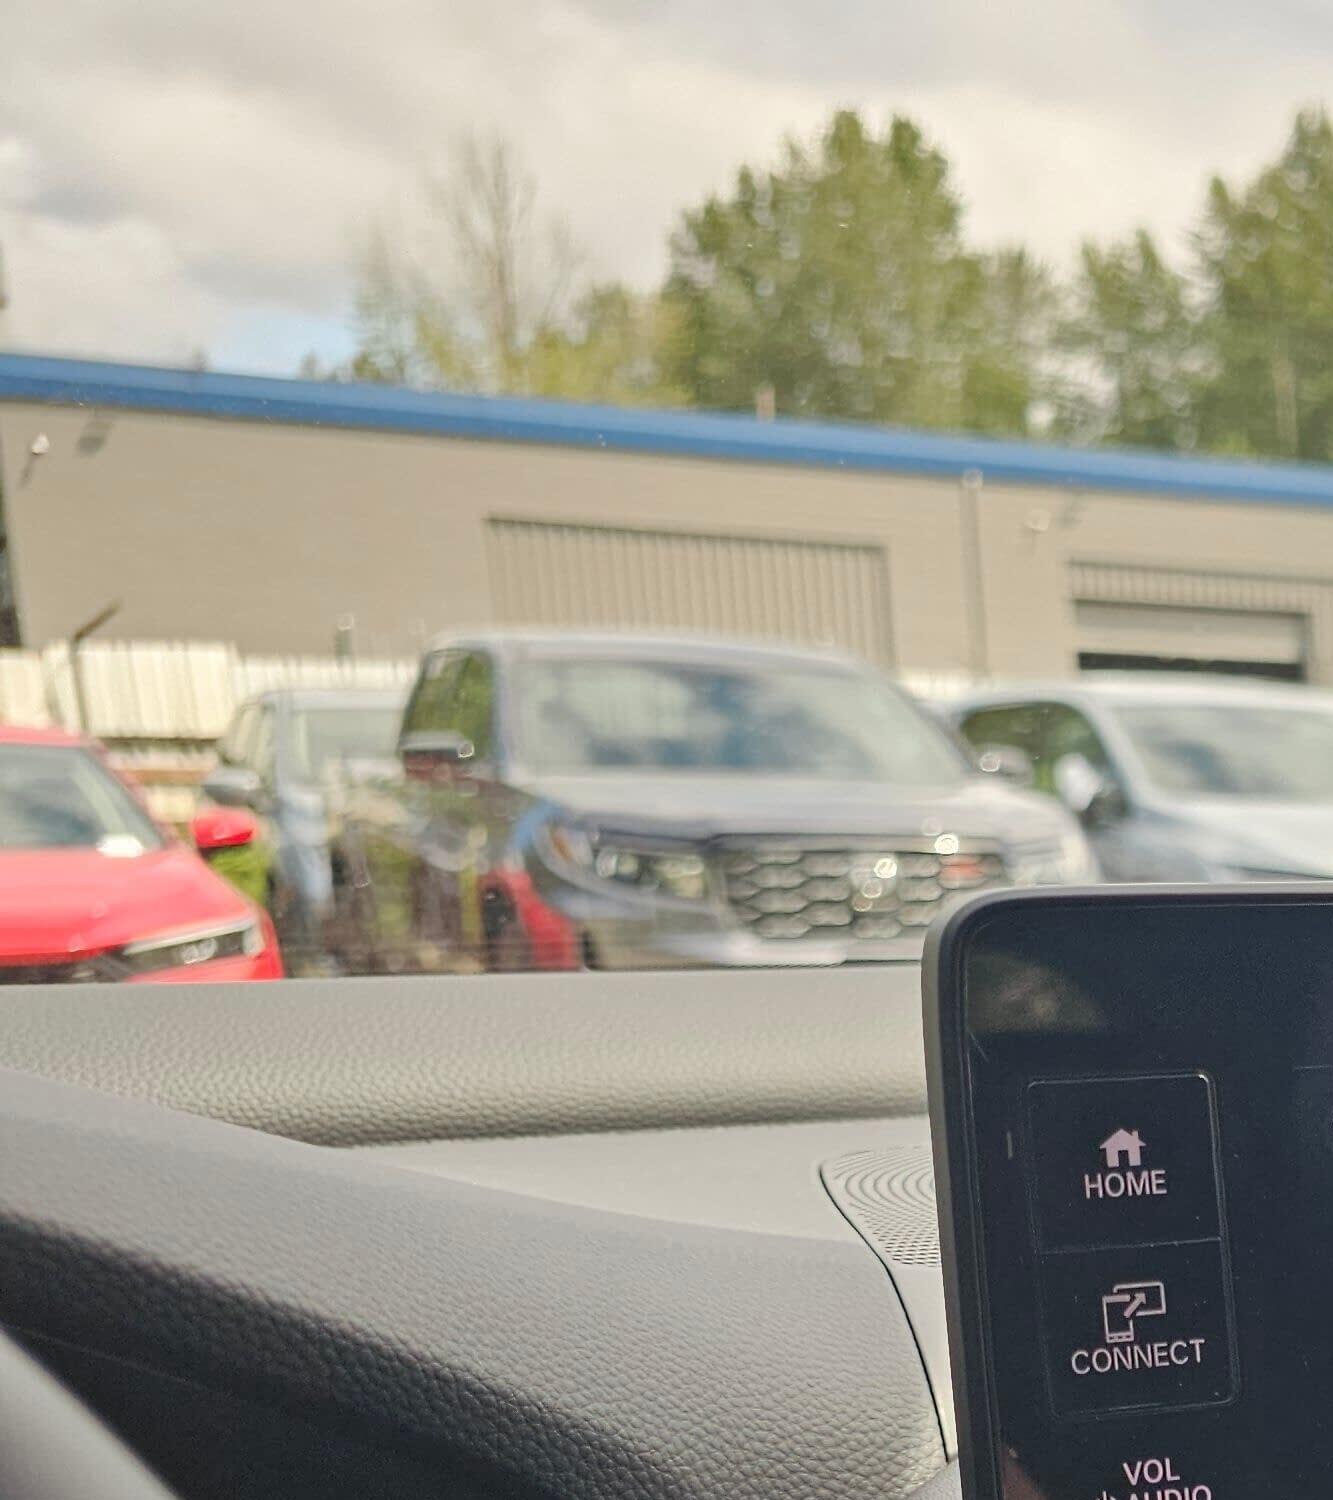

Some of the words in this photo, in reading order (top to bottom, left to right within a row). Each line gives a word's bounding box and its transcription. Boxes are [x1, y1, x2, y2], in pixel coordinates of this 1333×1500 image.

[1084, 1169, 1167, 1200] HOME
[1070, 1338, 1206, 1376] CONNECT
[1123, 1457, 1181, 1487] VOL
